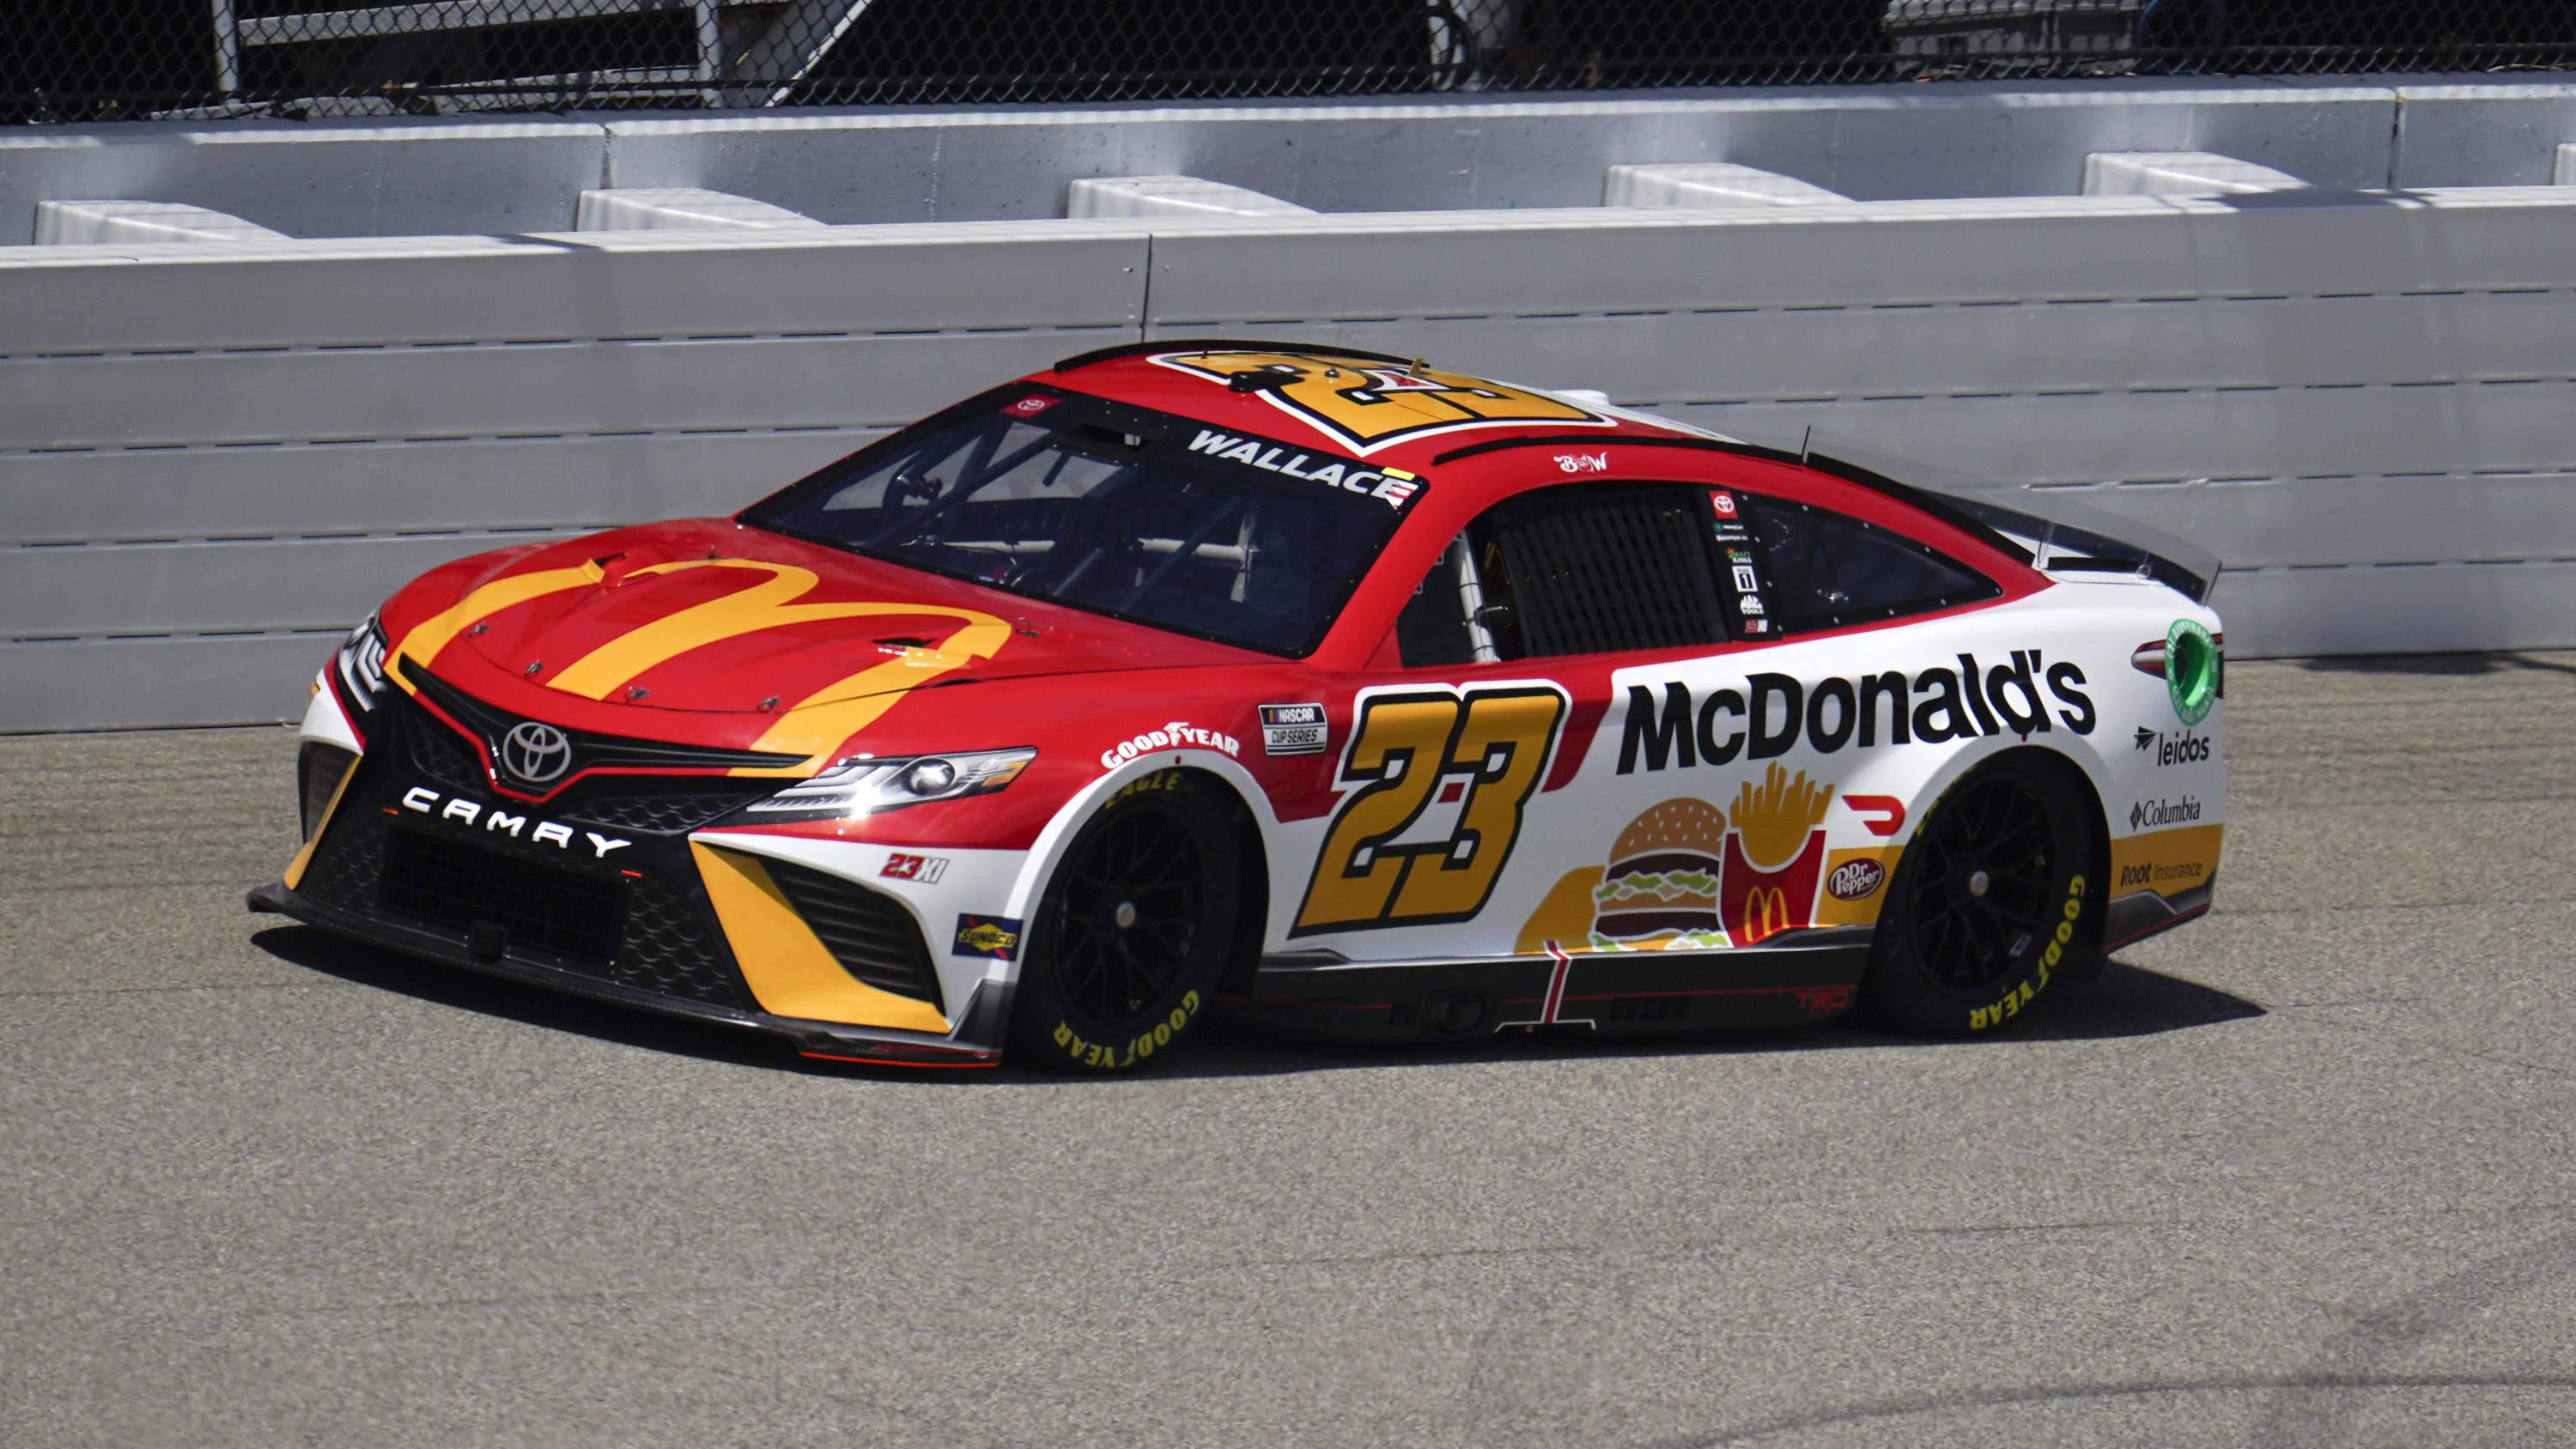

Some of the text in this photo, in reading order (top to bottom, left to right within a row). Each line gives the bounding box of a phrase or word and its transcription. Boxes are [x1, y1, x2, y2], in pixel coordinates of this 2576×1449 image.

[1188, 430, 1403, 500] WALLACE
[1279, 708, 1315, 723] NASCAR
[1616, 649, 2096, 775] McDonald's
[1101, 722, 1239, 769] GOODYEAR
[1272, 729, 1317, 743] CUP SERIES
[2158, 729, 2210, 767] leidos
[403, 787, 631, 858] CAMRY
[1290, 684, 1570, 939] 23
[2143, 796, 2201, 827] Columbia
[1836, 867, 1879, 895] Pepper
[1849, 863, 1868, 881] Dr
[2120, 861, 2152, 887] Root
[959, 930, 1018, 946] SUNOCO
[1970, 874, 2086, 1030] GOODYEAR
[1054, 990, 1200, 1068] GOODYEAR
